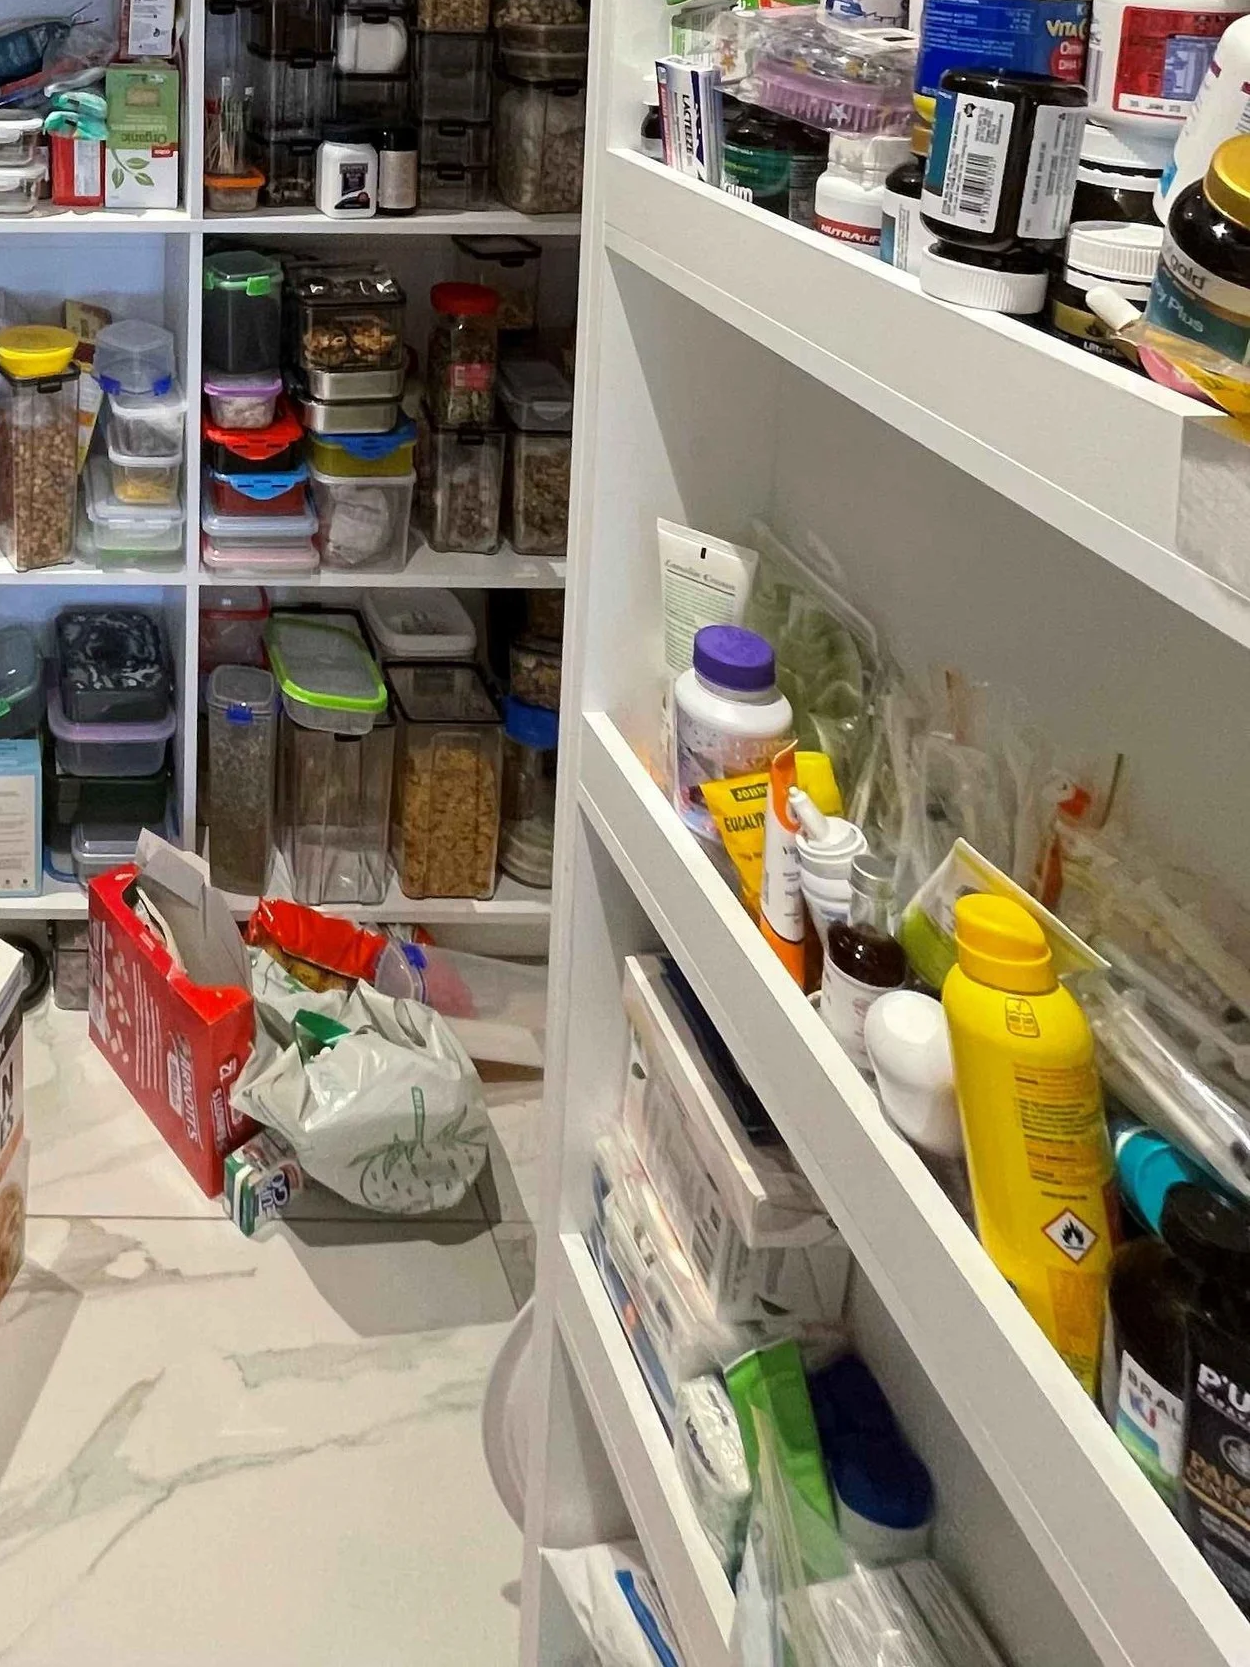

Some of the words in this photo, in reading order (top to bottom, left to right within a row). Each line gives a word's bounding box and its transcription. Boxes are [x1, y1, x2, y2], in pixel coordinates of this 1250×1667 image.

[681, 92, 695, 157] LACTEEZE
[121, 133, 167, 145] Organic
[820, 222, 881, 245] NUTRA-LIF
[1170, 254, 1206, 290] gold
[1167, 300, 1205, 333] Plus
[724, 811, 766, 834] EUCALYP
